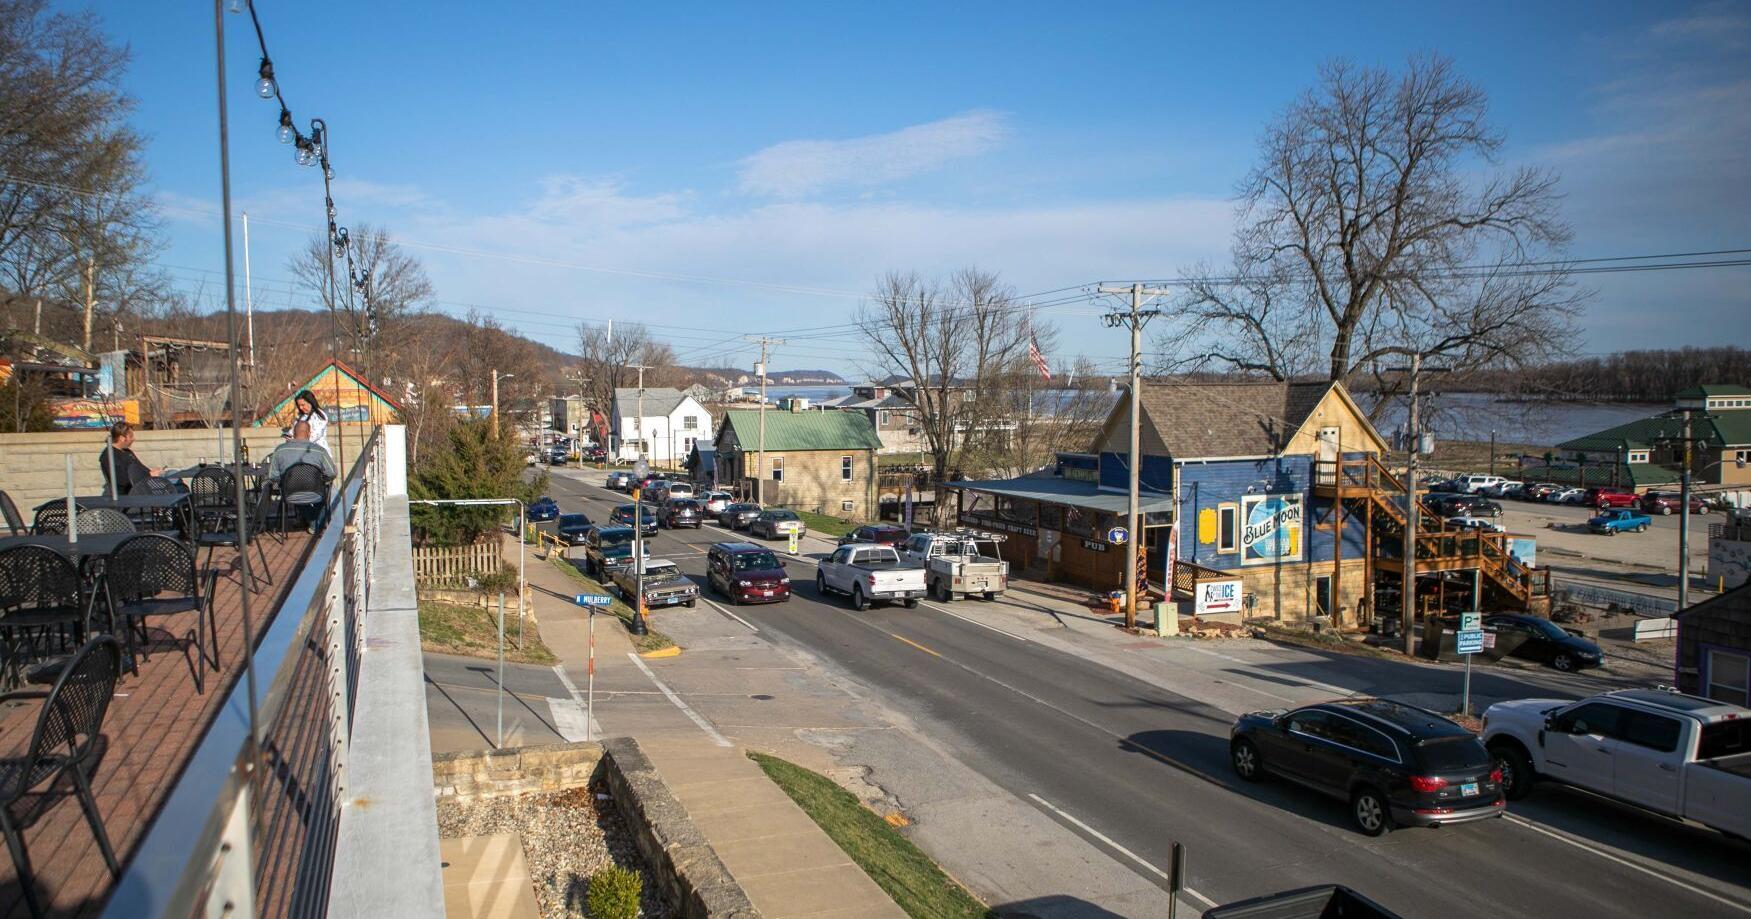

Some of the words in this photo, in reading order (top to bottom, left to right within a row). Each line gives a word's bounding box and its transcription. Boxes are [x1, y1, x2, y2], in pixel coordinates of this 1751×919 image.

[1244, 520, 1272, 544] BLUE
[1273, 507, 1300, 529] MOON
[1084, 540, 1105, 551] PUB
[1222, 584, 1234, 598] ICE
[583, 595, 611, 604] MULBERRY
[1464, 616, 1472, 628] P
